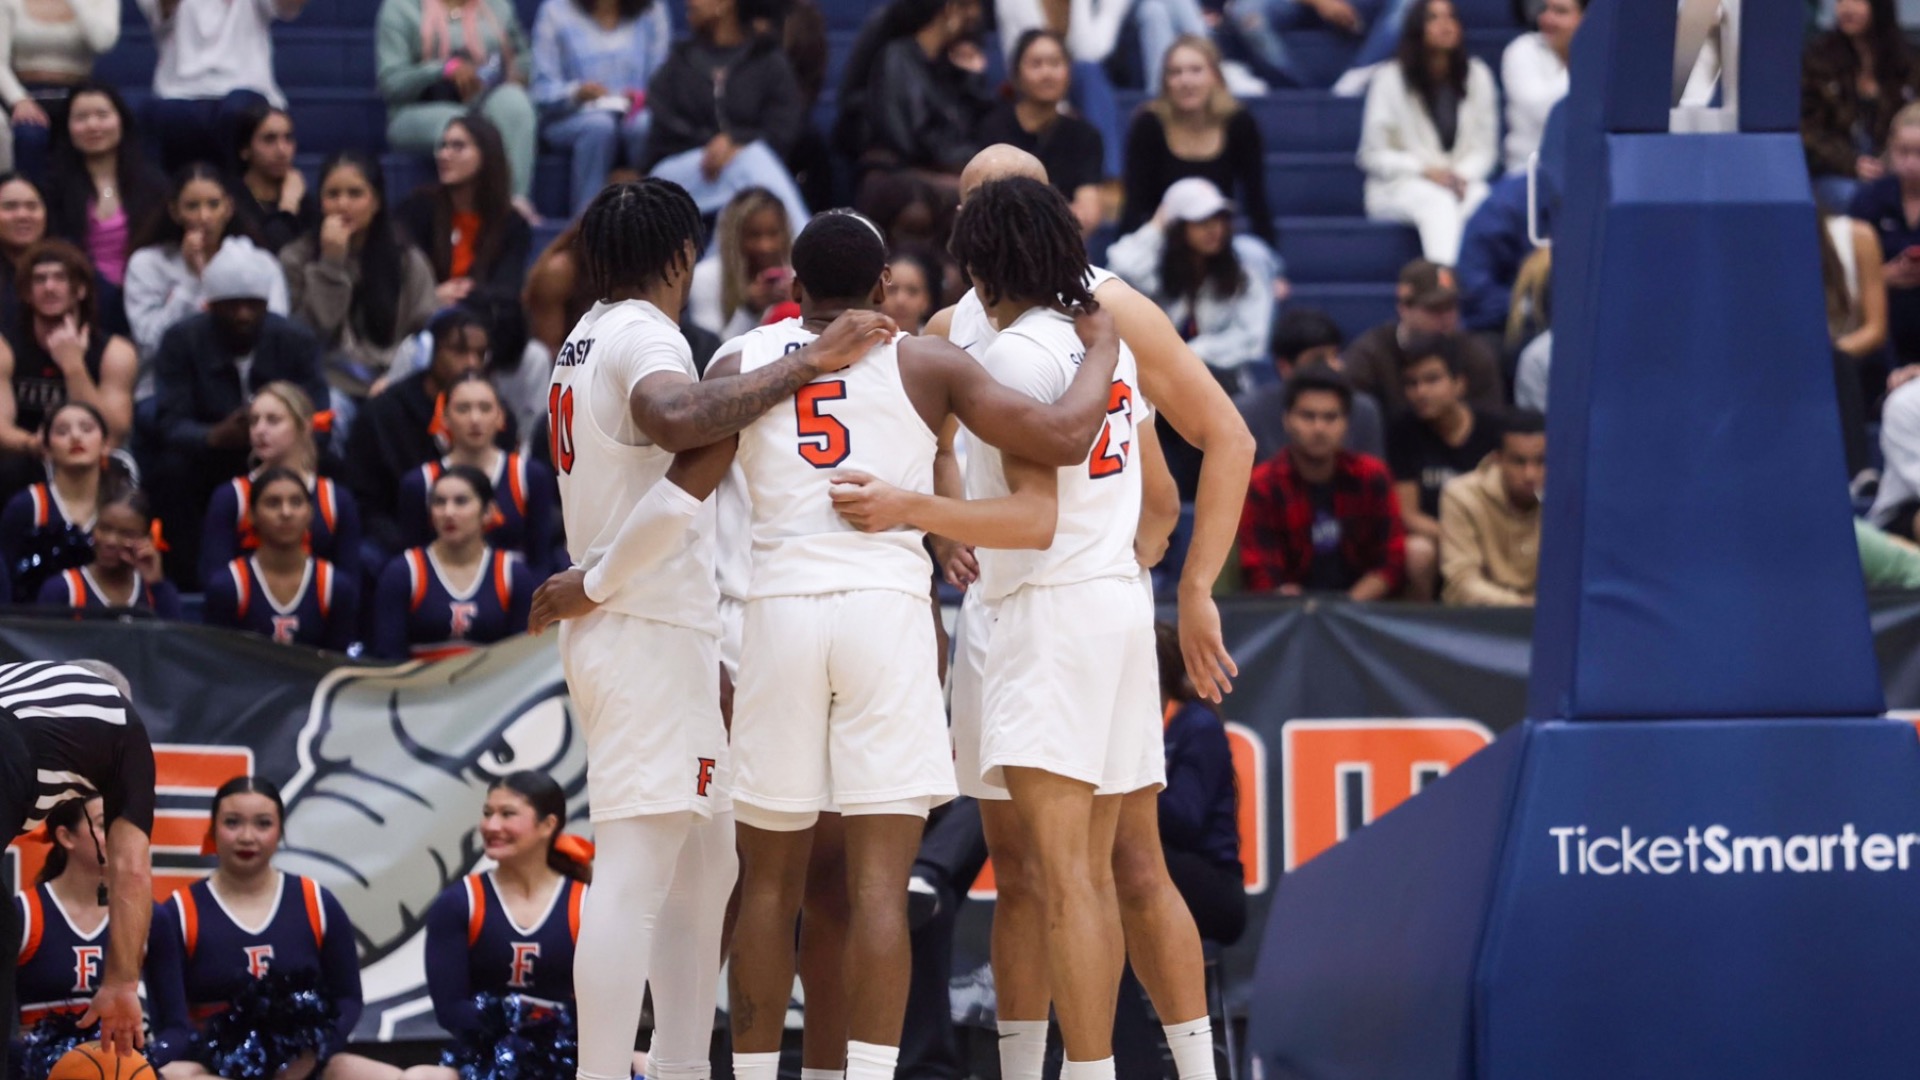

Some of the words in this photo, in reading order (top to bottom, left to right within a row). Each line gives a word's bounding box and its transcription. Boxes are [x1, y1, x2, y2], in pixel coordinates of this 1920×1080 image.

[549, 382, 576, 477] 10
[794, 379, 851, 470] 5
[1088, 378, 1132, 480] 23
[696, 756, 716, 798] F
[1549, 823, 1917, 876] TicketSmarter
[71, 945, 103, 992] F
[243, 944, 275, 981] F
[507, 941, 541, 988] F
